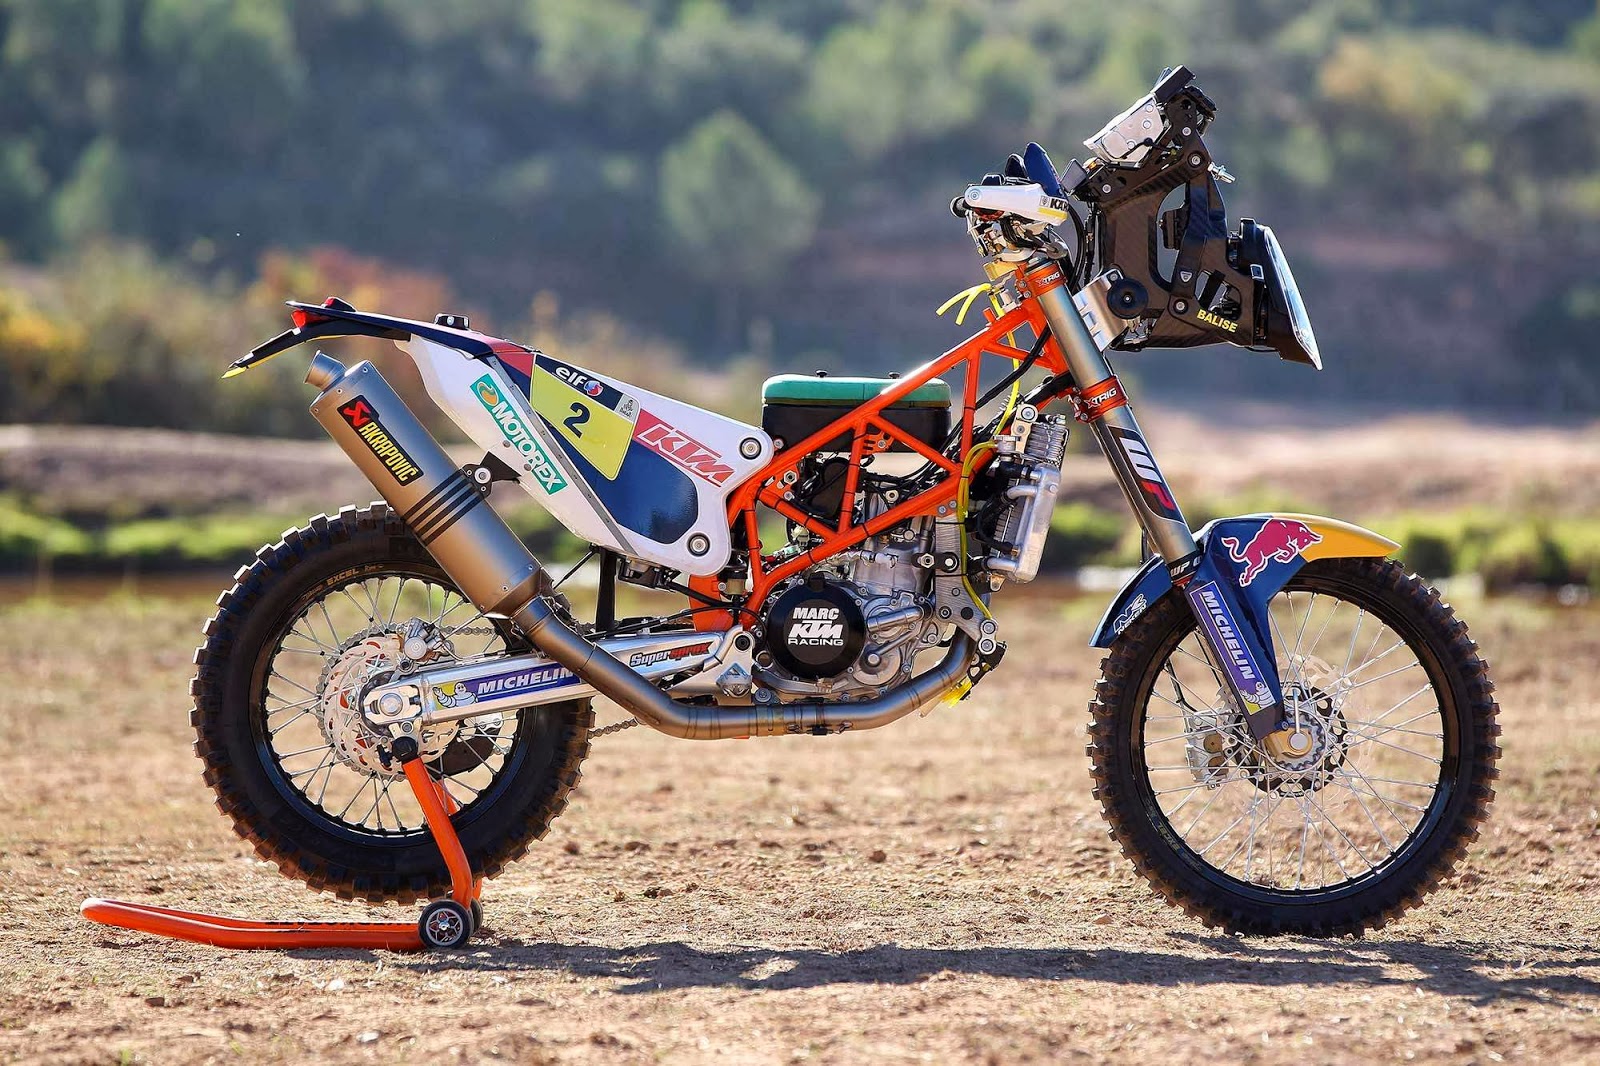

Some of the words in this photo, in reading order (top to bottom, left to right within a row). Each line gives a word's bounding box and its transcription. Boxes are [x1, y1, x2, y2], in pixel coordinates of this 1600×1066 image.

[1036, 271, 1061, 288] XTRIG
[1196, 309, 1239, 333] BALISE
[555, 366, 588, 387] elf
[1084, 387, 1118, 409] XTRIG
[563, 401, 592, 439] 2
[491, 400, 562, 492] MOTOREX
[637, 422, 735, 486] KTM
[1120, 437, 1176, 511] WP
[326, 568, 360, 585] EXCEL
[792, 607, 840, 620] MARC
[787, 619, 844, 639] KTM
[1200, 590, 1256, 681] MICHELIN
[787, 637, 844, 647] RACING
